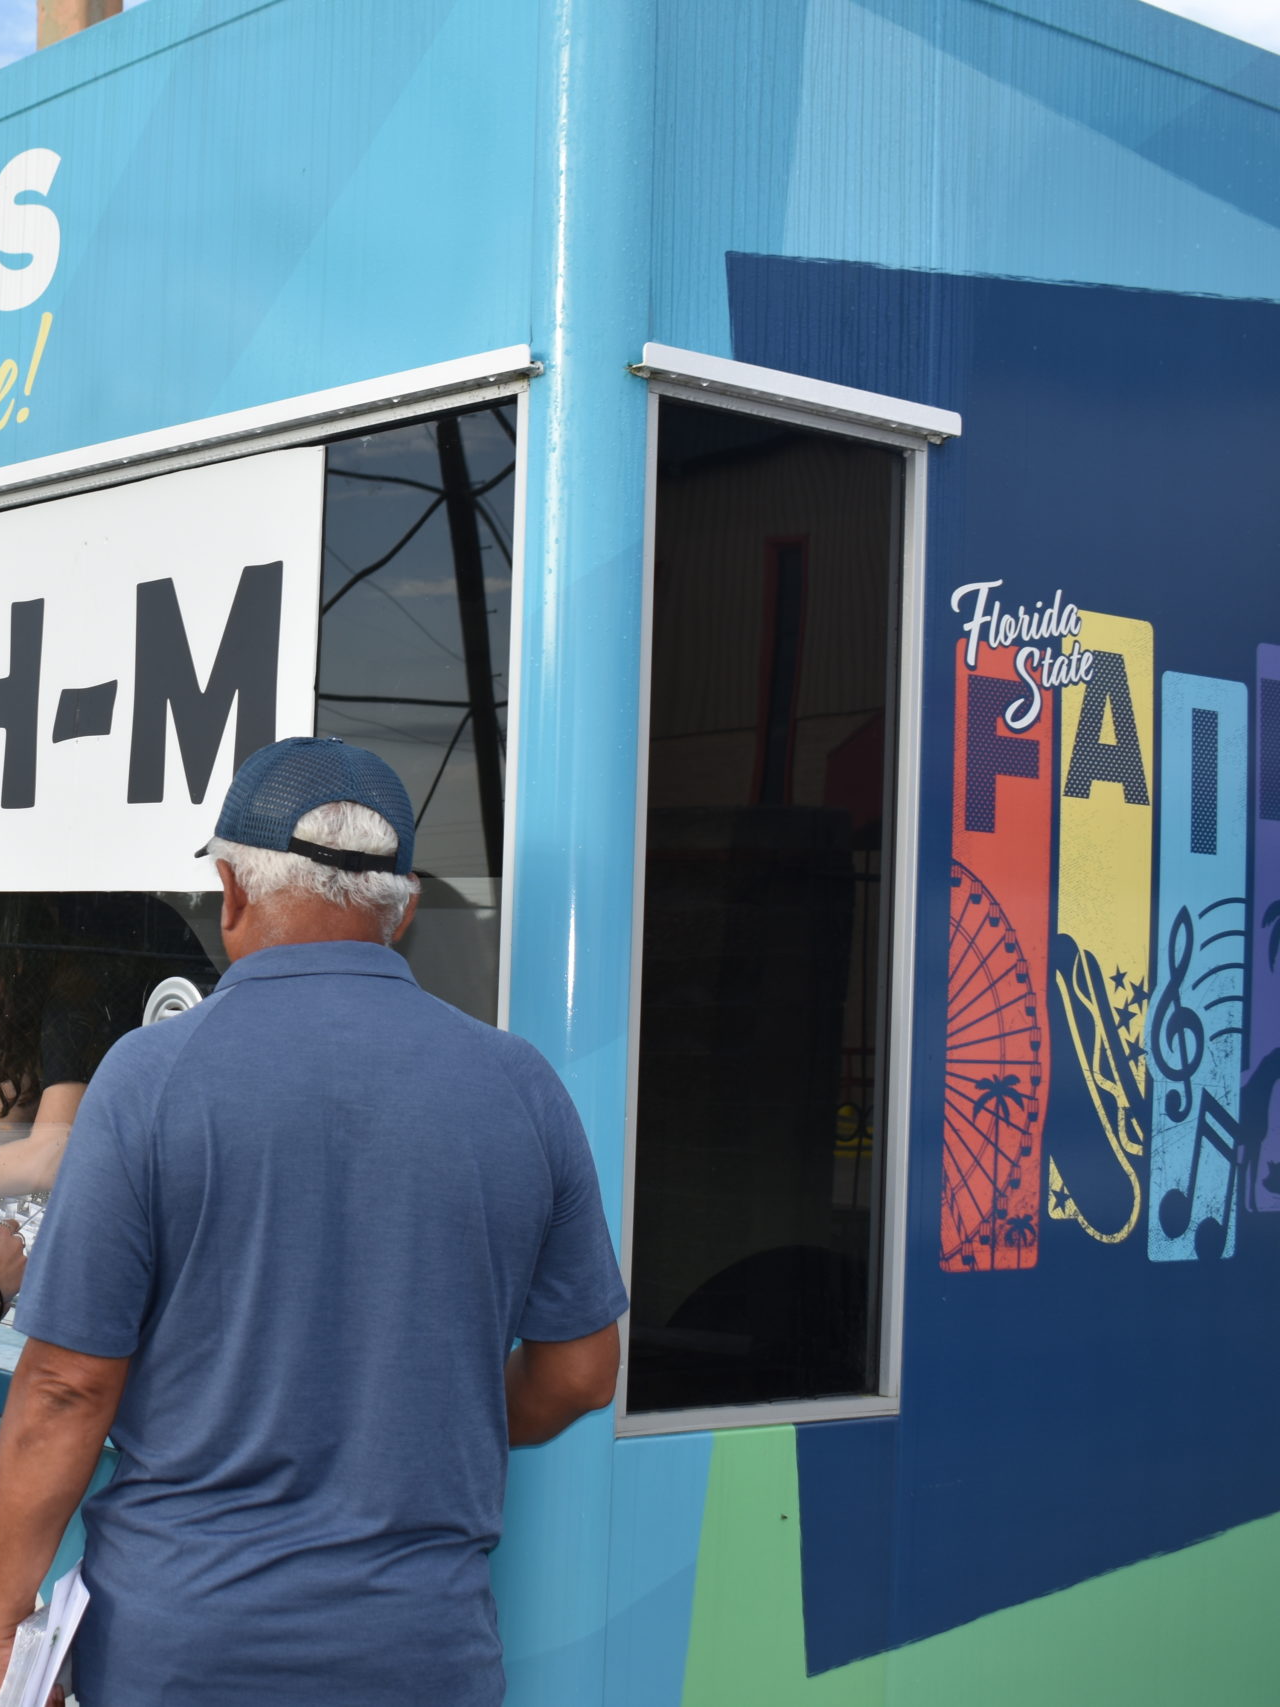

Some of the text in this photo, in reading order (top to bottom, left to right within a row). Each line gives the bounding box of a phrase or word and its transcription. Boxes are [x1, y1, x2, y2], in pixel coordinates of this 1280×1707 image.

[950, 579, 1081, 666] Florida
[1004, 641, 1094, 730] State
[964, 650, 1280, 855] FAI
